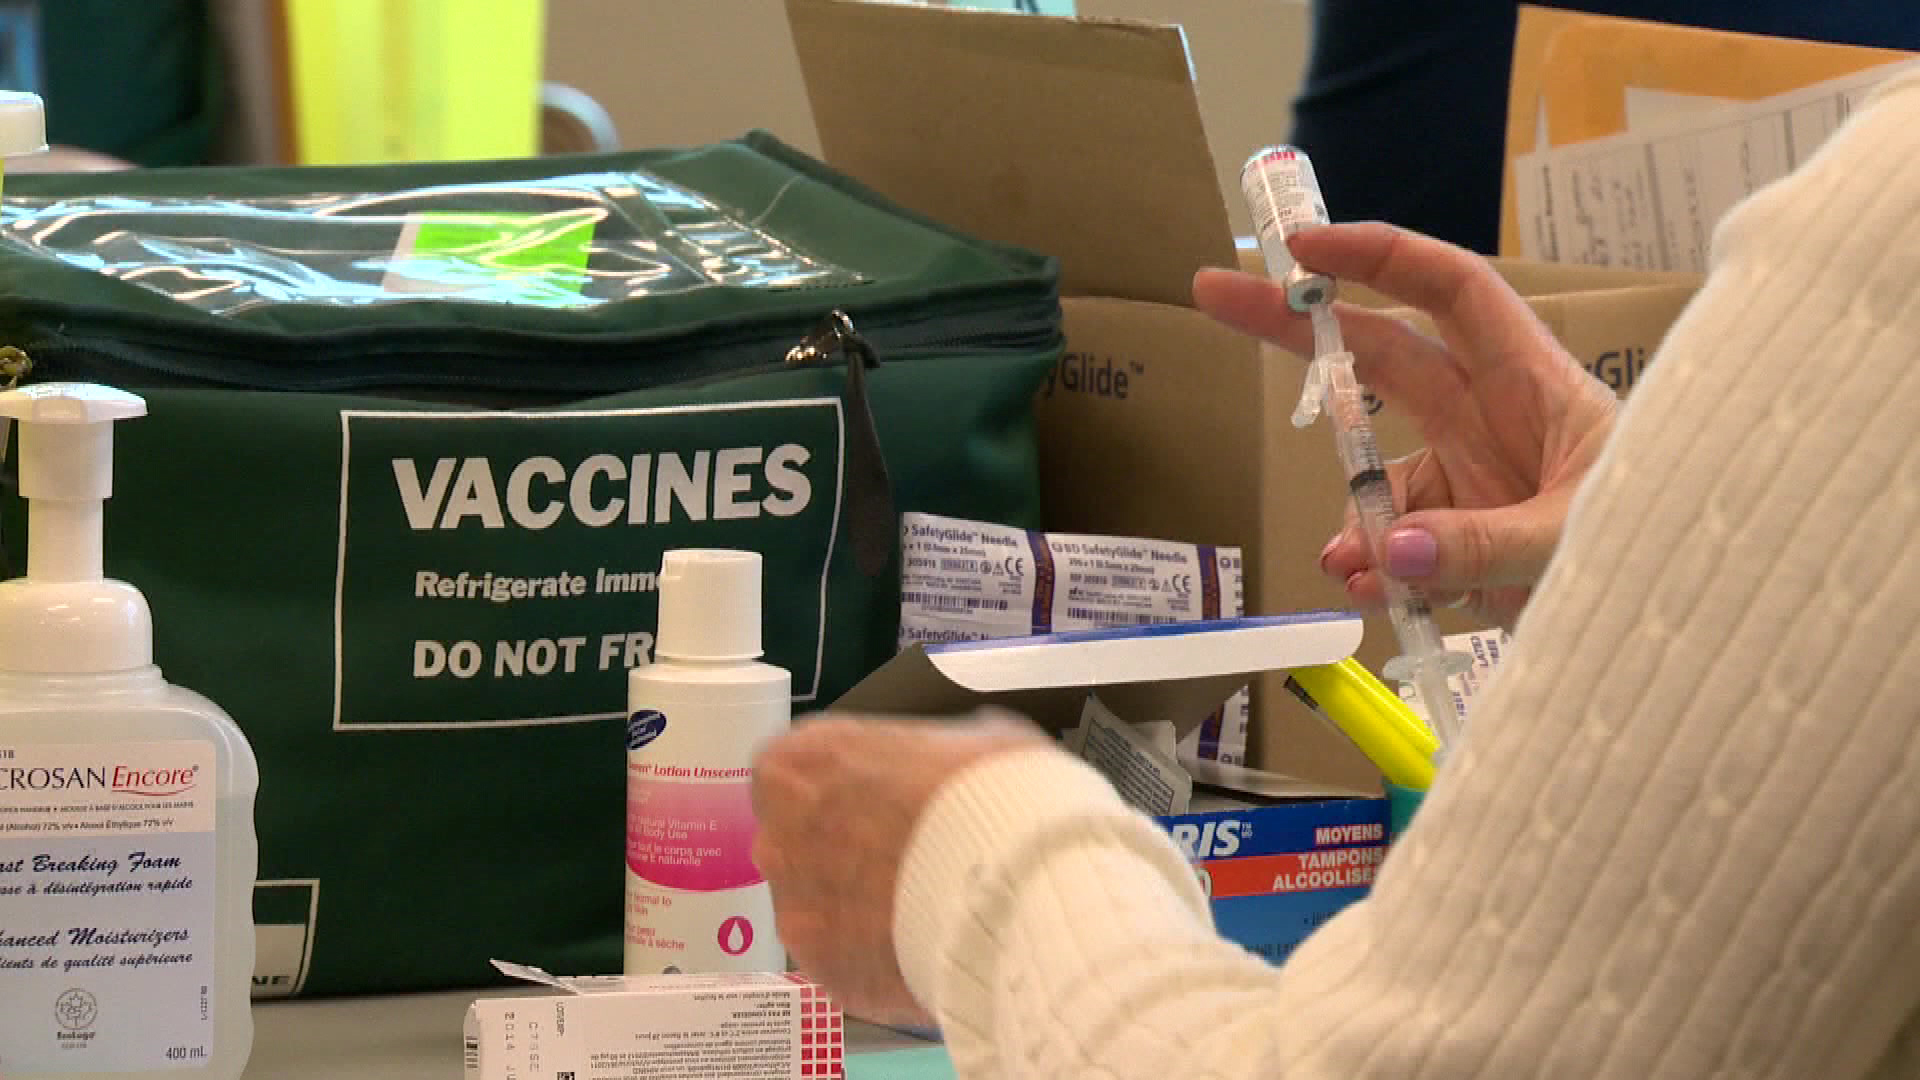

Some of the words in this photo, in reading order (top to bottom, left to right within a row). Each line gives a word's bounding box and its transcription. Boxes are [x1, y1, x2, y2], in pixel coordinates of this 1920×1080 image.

[392, 444, 812, 530] VACCINES
[981, 533, 1017, 546] Needle
[1151, 551, 1187, 564] Needle
[415, 569, 586, 602] Refrigerate
[413, 640, 482, 678] DO
[494, 637, 586, 677] NOT
[654, 764, 690, 777] Lotion
[668, 819, 706, 831] Vitamin
[709, 820, 717, 831] E
[1315, 823, 1383, 845] MOYENS
[32, 853, 119, 876] Breaking
[128, 851, 181, 873] Foam
[1297, 848, 1384, 871] TAMPONS
[43, 879, 143, 897] désintégration
[148, 876, 192, 892] rapide
[68, 927, 189, 948] Moisturizers
[41, 955, 58, 968] de
[64, 953, 115, 972] qualité
[120, 953, 192, 969] supérieure
[166, 1047, 186, 1060] 400
